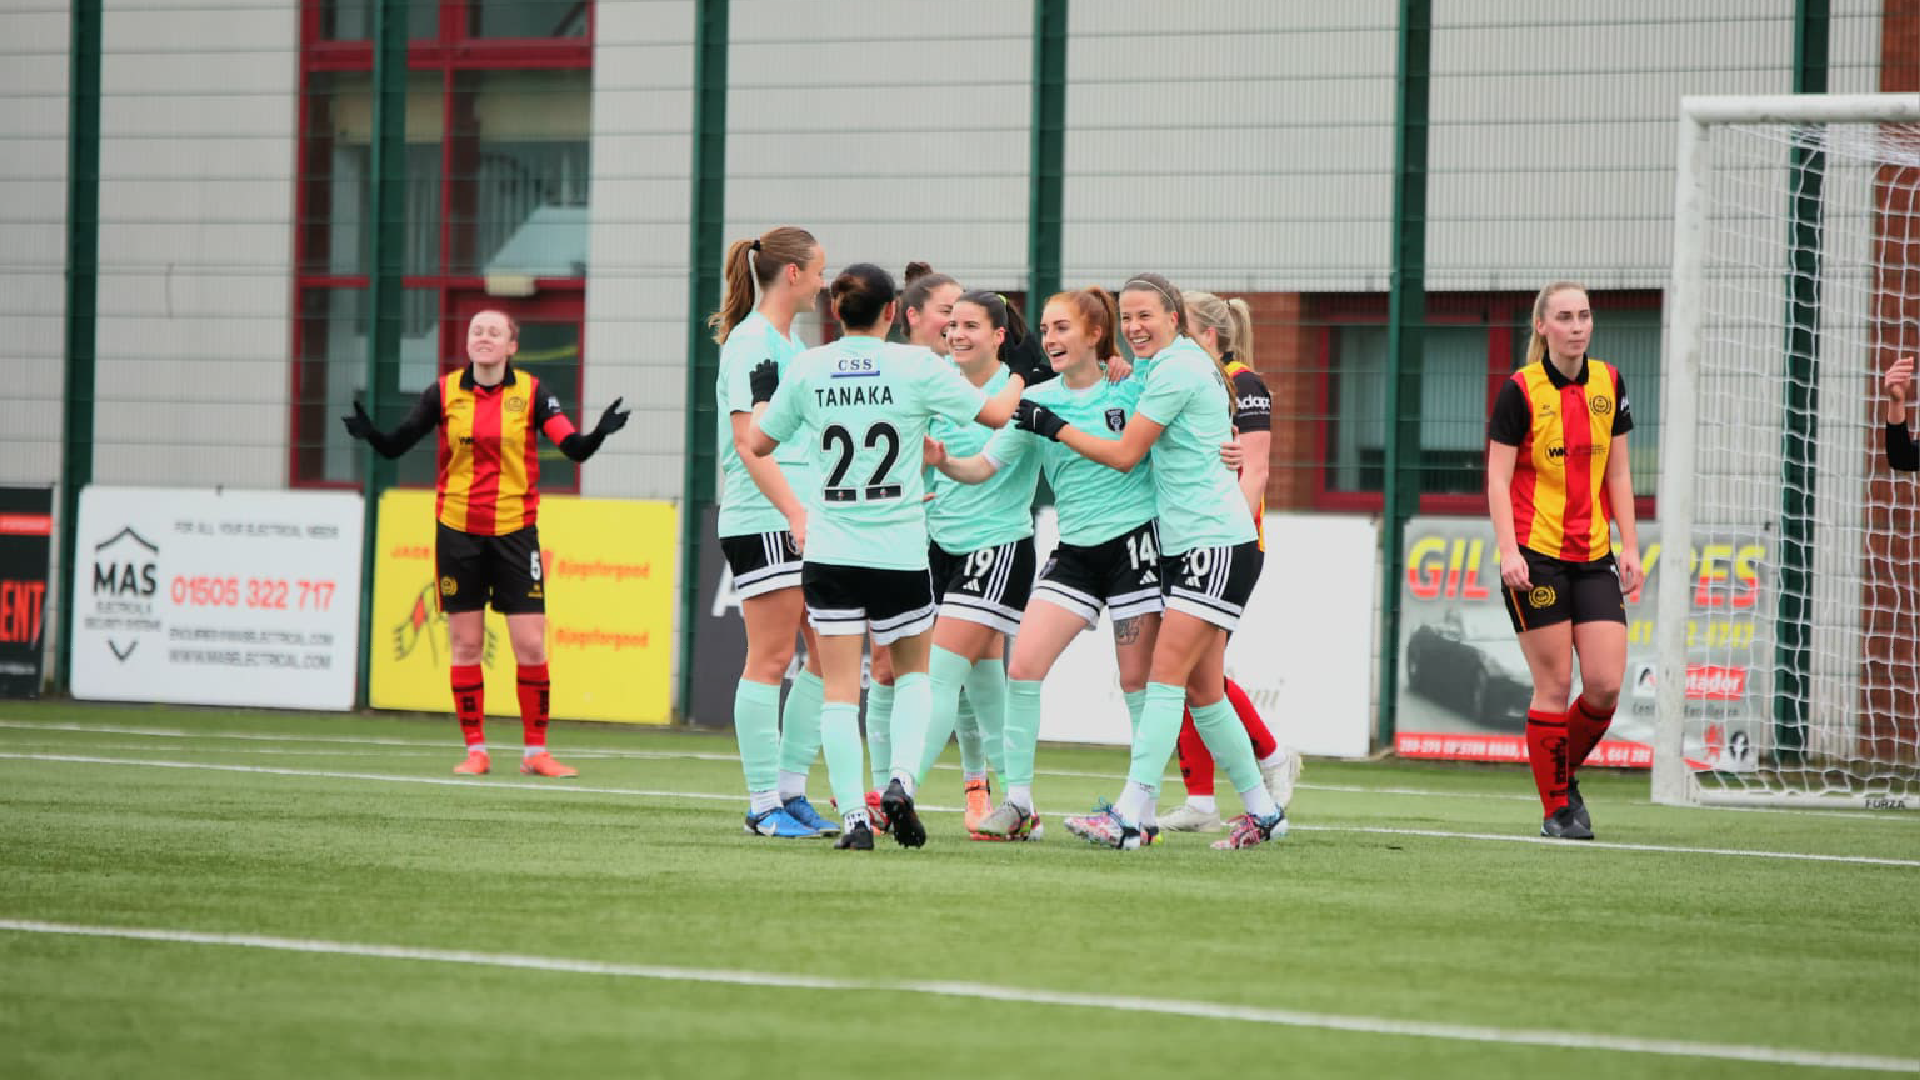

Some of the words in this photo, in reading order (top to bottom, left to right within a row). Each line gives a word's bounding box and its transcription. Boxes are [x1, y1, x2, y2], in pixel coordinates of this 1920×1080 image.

[838, 359, 872, 371] CSS
[815, 386, 894, 407] TANAKA
[821, 421, 903, 502] 22
[530, 551, 541, 581] 5
[963, 550, 995, 577] 19
[1126, 531, 1157, 570] 14
[93, 562, 156, 596] MAS
[171, 575, 239, 607] 01505
[247, 578, 289, 611] 322
[296, 580, 336, 612] 717
